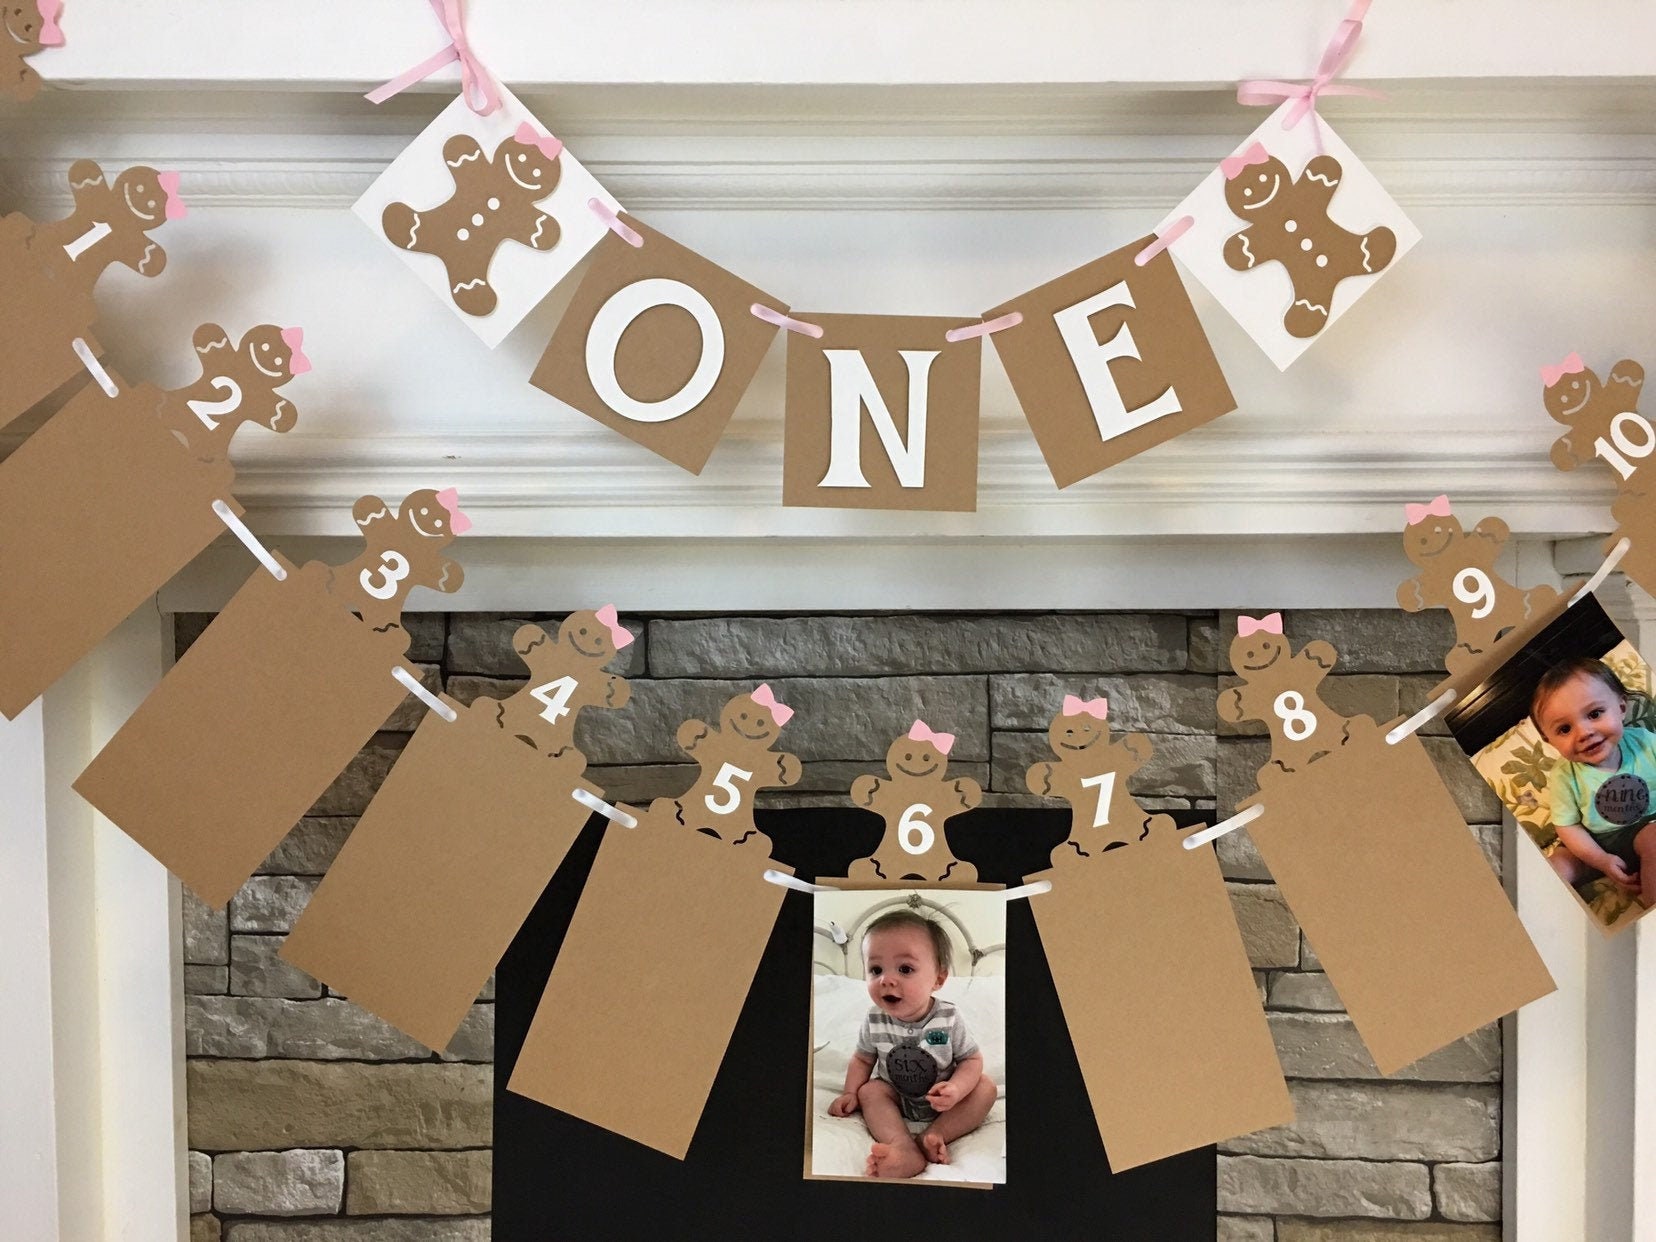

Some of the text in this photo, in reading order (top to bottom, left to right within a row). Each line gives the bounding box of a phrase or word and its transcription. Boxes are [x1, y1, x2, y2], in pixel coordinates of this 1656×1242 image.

[63, 221, 112, 262] 1
[187, 376, 242, 431] 2
[586, 278, 1182, 488] ONE
[1595, 411, 1656, 481] 10
[359, 550, 410, 600] 3
[1452, 567, 1496, 619] 9
[529, 675, 578, 725] 4
[1274, 690, 1318, 742] 8
[704, 762, 753, 815] 5
[1081, 772, 1116, 828] 7
[1602, 783, 1646, 802] nine
[897, 803, 936, 856] 6
[895, 1054, 928, 1073] six
